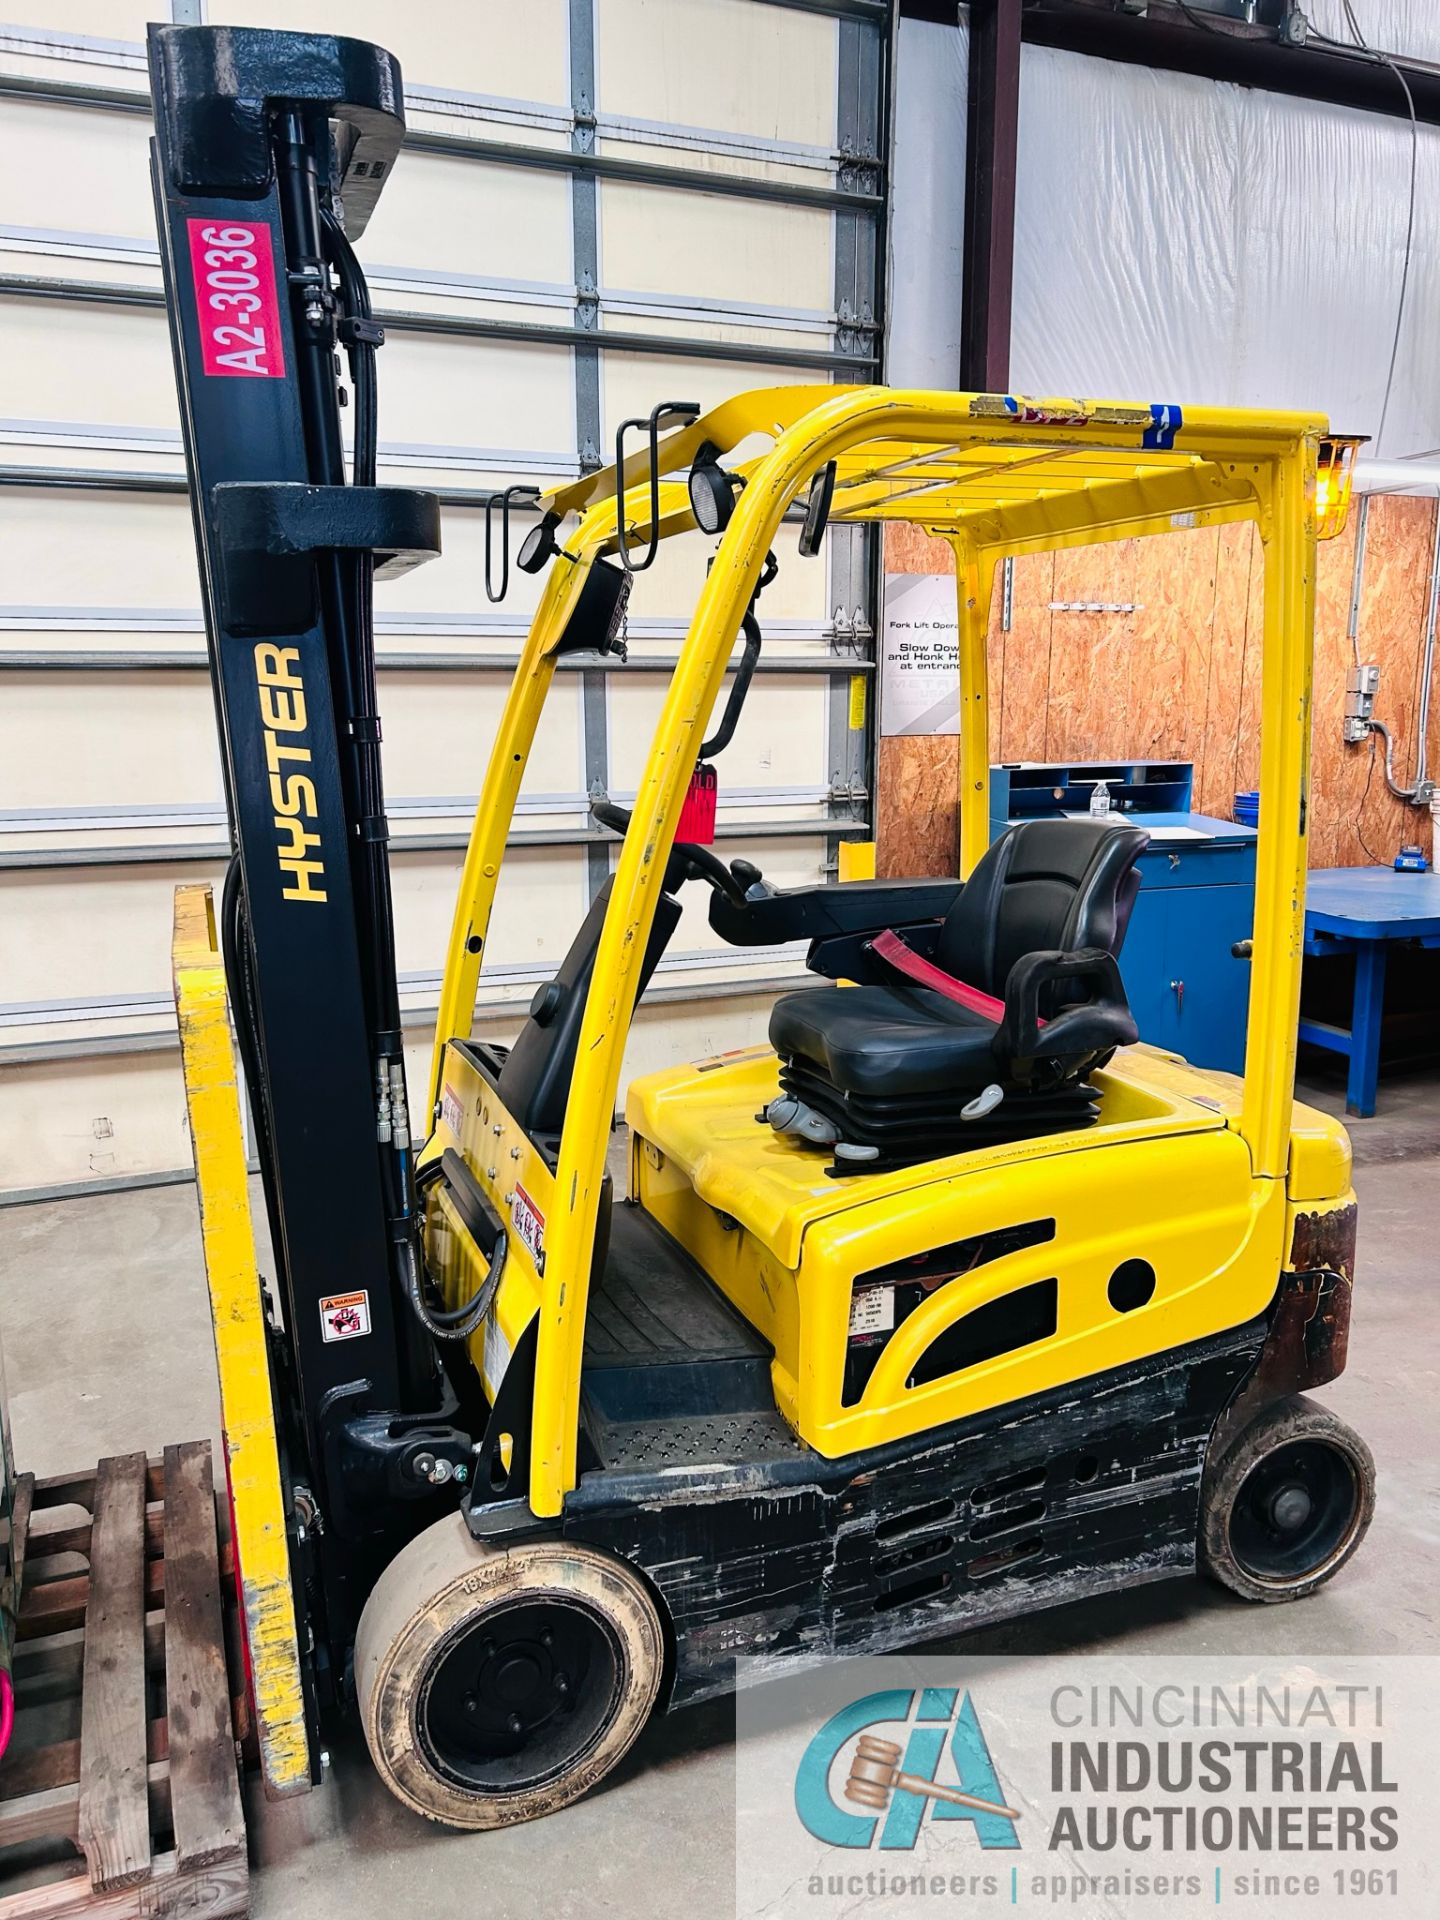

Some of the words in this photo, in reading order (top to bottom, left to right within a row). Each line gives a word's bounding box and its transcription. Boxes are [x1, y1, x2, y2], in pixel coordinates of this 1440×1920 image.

[201, 227, 269, 375] A2-3036
[889, 621, 911, 629] Fork
[914, 621, 930, 629] Lift
[899, 643, 929, 652] Slow
[888, 652, 910, 661] and
[913, 652, 944, 661] Honk
[948, 652, 960, 661] H
[900, 662, 912, 670] at
[254, 642, 327, 902] HYSTER
[334, 1296, 363, 1306] WARNING
